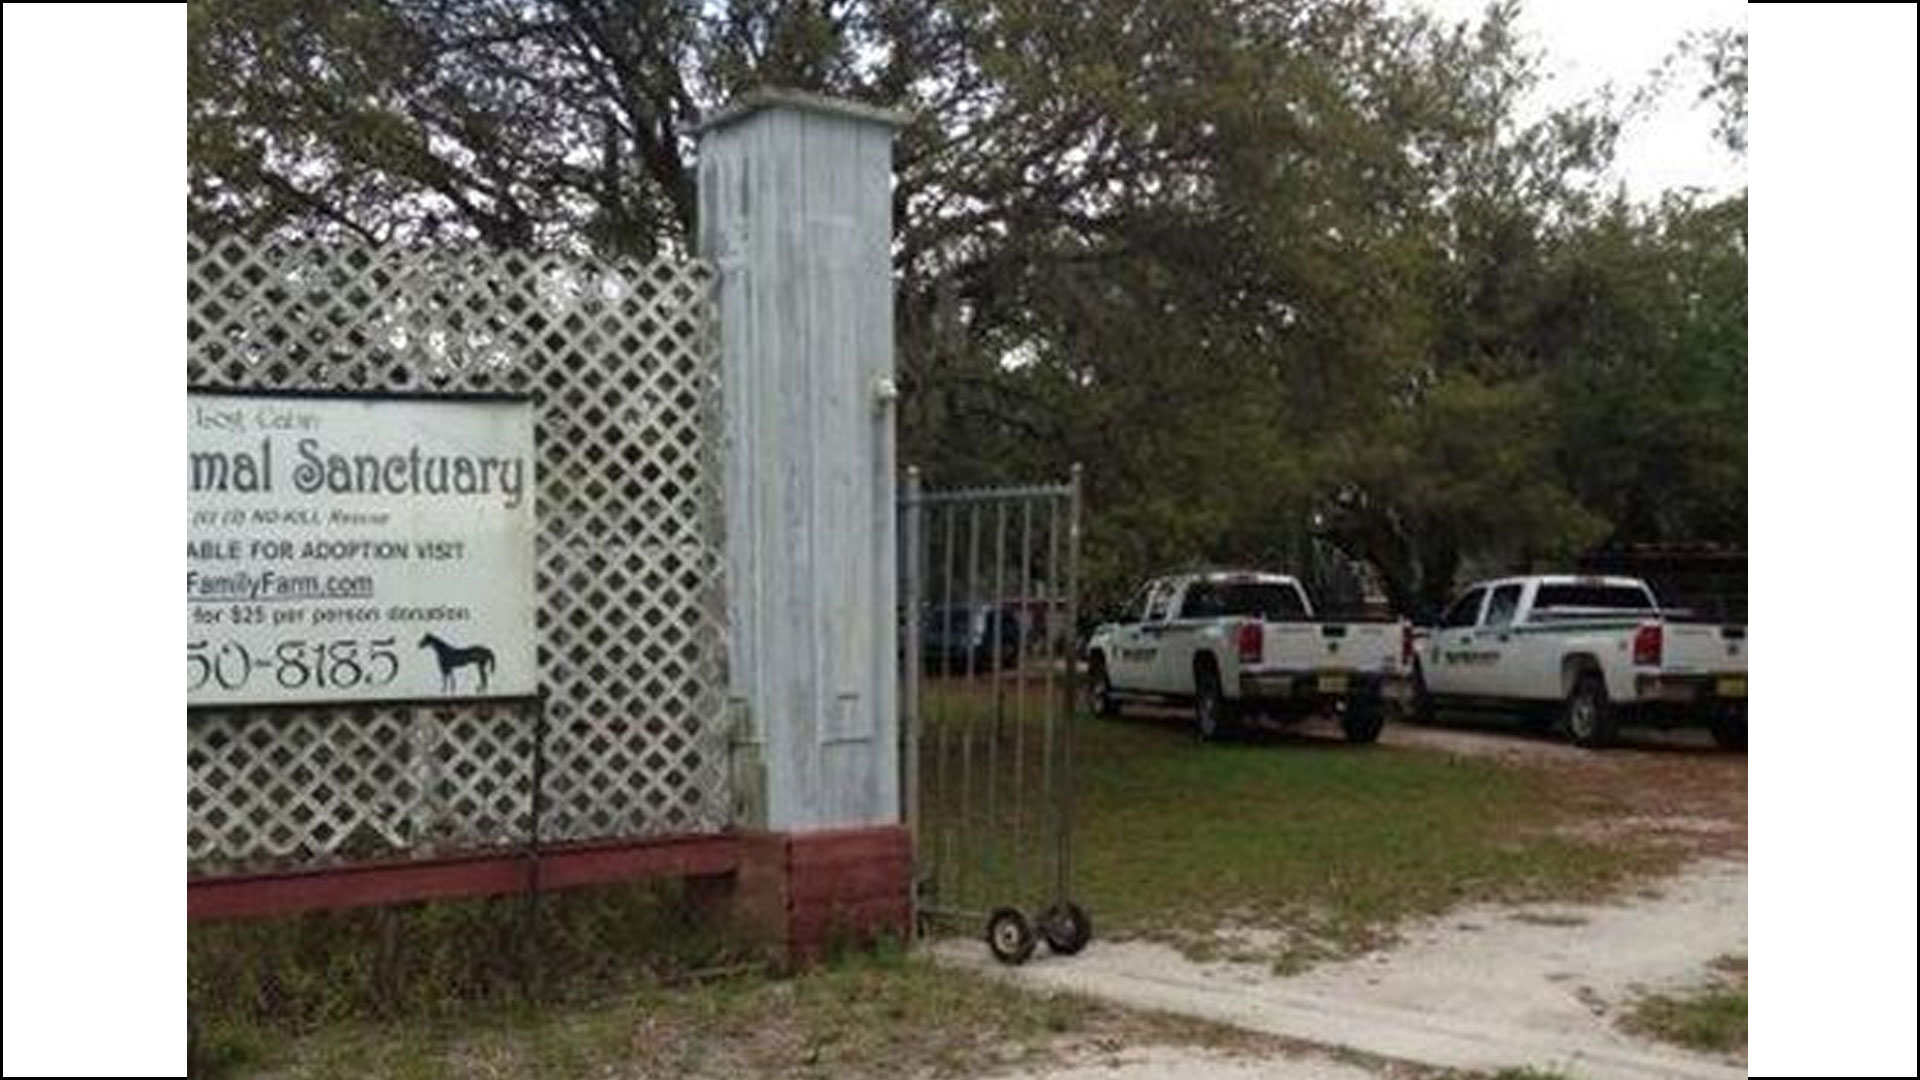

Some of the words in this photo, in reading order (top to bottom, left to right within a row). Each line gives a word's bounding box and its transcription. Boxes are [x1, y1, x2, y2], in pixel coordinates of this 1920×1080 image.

[293, 437, 524, 508] Sanctuary
[250, 540, 294, 560] FOR
[302, 540, 409, 560] ADOPTION
[416, 541, 465, 559] VISIT
[187, 570, 374, 599] FamilyFarm.com
[194, 608, 220, 623] for
[231, 606, 264, 624] $25
[273, 609, 303, 626] per
[312, 608, 379, 626] person
[388, 605, 470, 623] donation
